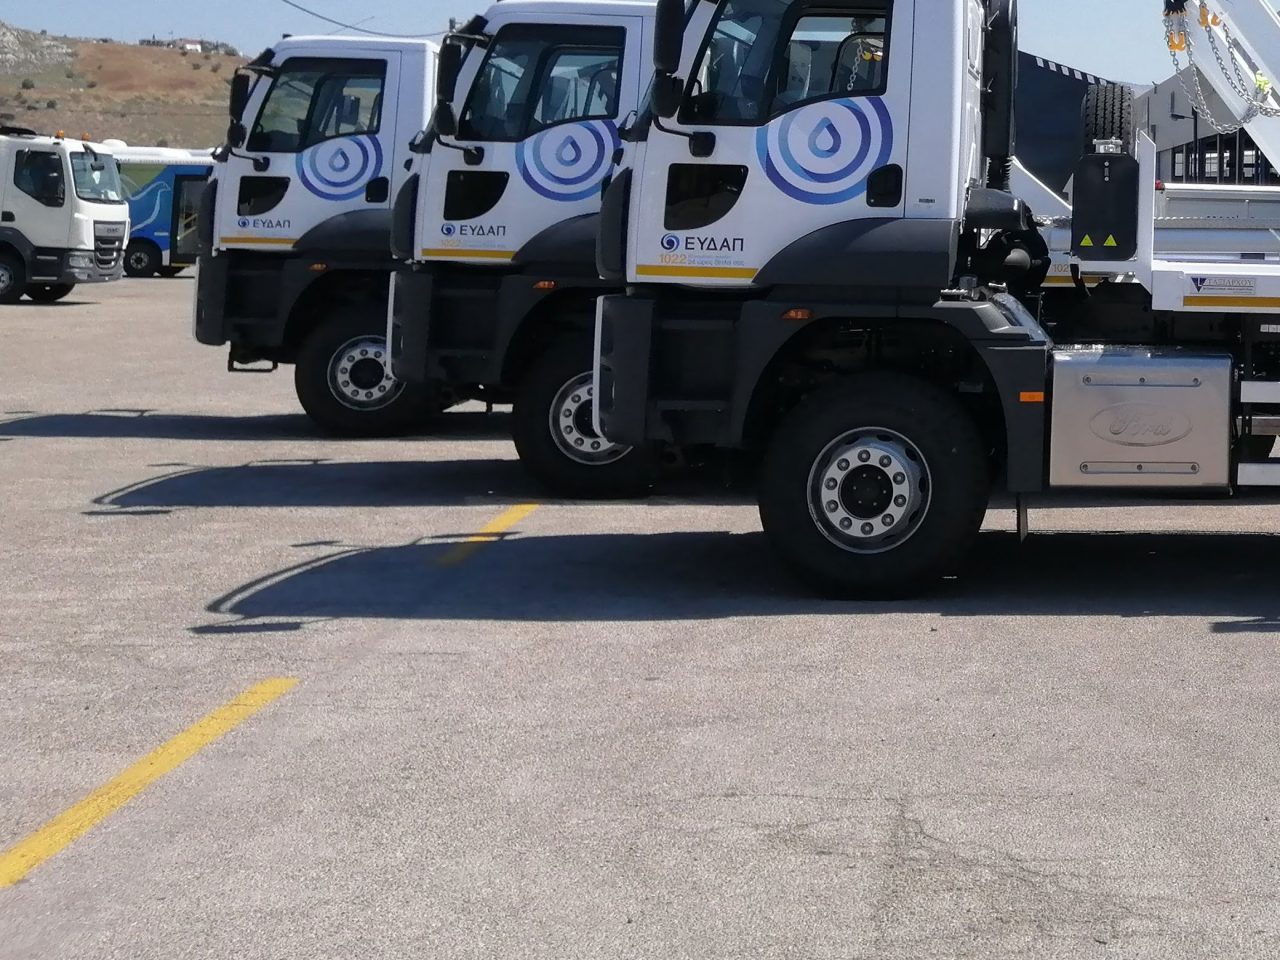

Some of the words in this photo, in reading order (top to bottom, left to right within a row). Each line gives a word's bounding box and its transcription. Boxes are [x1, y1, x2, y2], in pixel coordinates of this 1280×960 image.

[252, 219, 291, 229] ΕΥΔΑΠ
[460, 224, 506, 236] ΕΥΔΑΠ
[684, 237, 744, 252] ΕΥΔΑΠ
[659, 253, 687, 265] 1022
